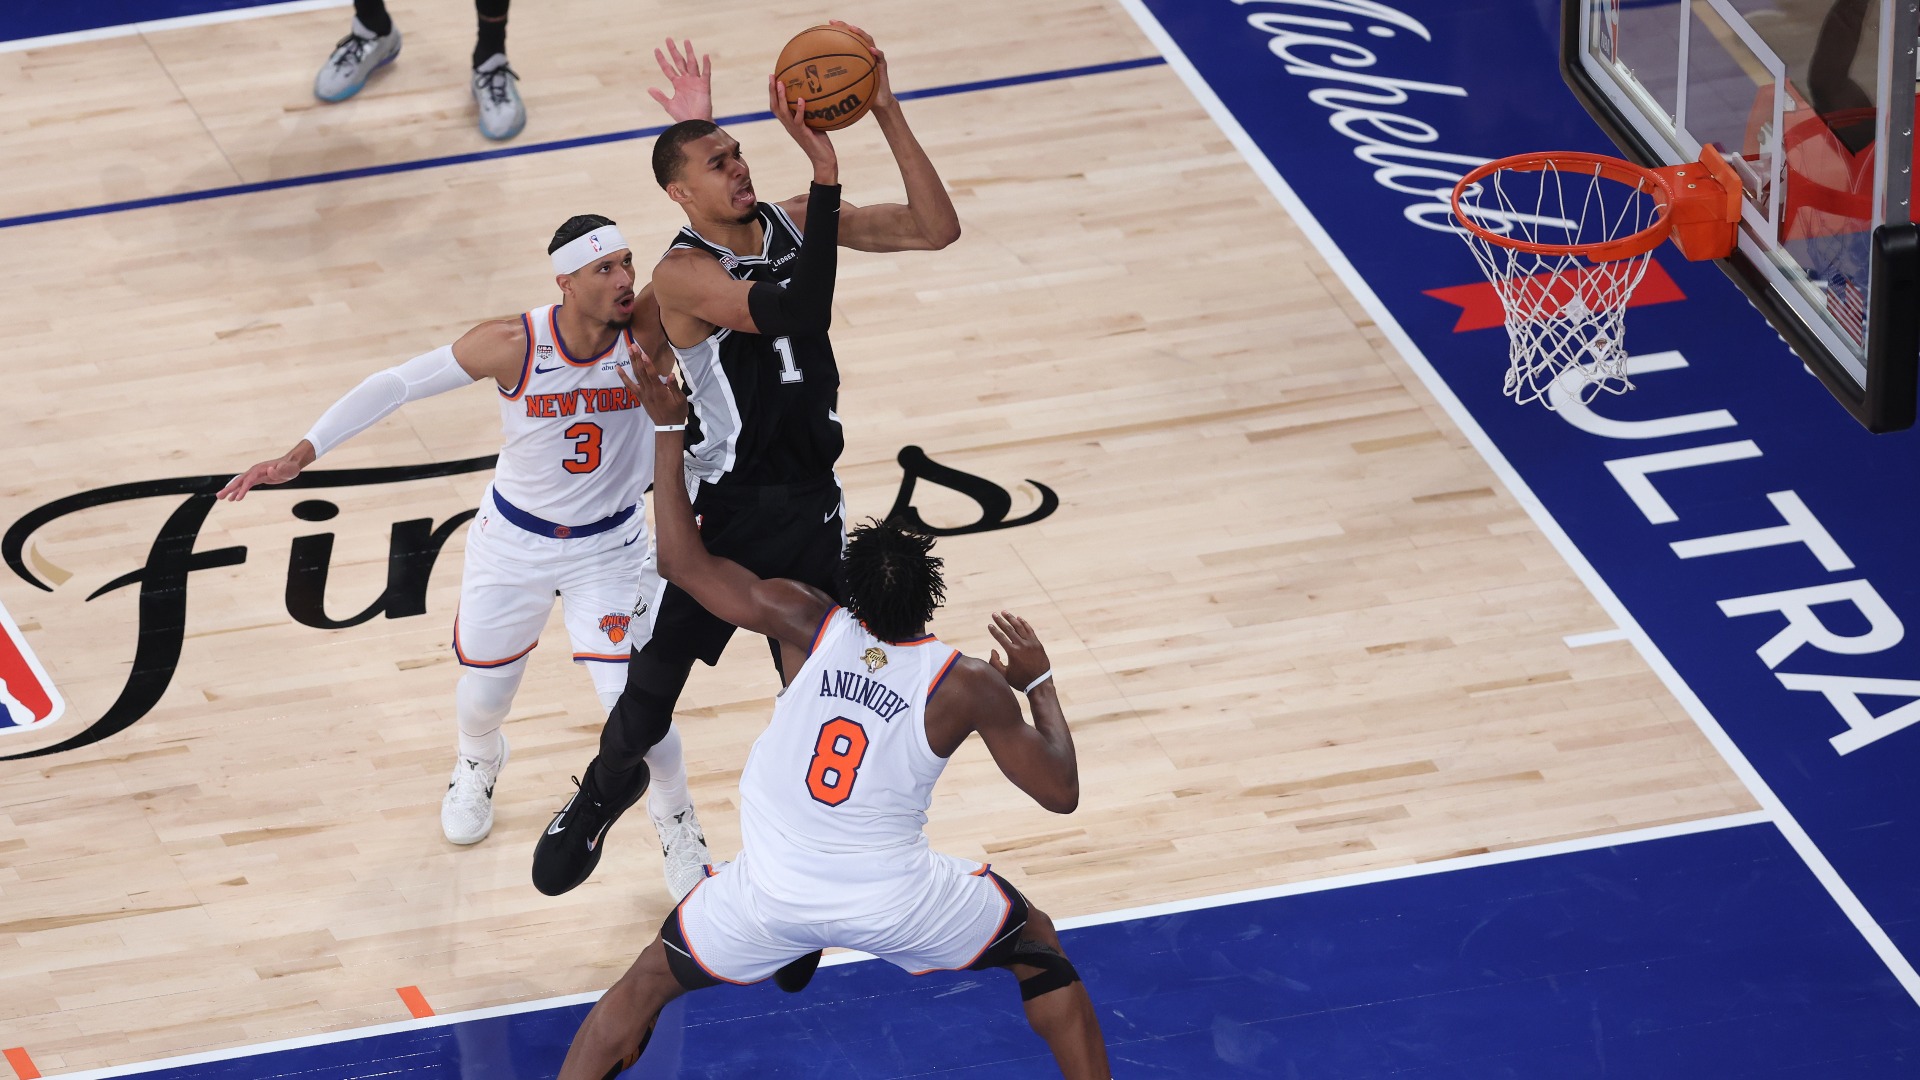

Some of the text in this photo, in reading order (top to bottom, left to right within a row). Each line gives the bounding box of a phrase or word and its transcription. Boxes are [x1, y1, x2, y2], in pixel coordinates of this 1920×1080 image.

[773, 252, 796, 267] LEDGER
[772, 336, 804, 384] 1
[525, 386, 641, 418] NEW YORK
[562, 422, 603, 474] 3
[1548, 350, 1920, 756] ULTRA
[820, 669, 910, 723] ANUNOBY
[805, 716, 870, 808] 8
